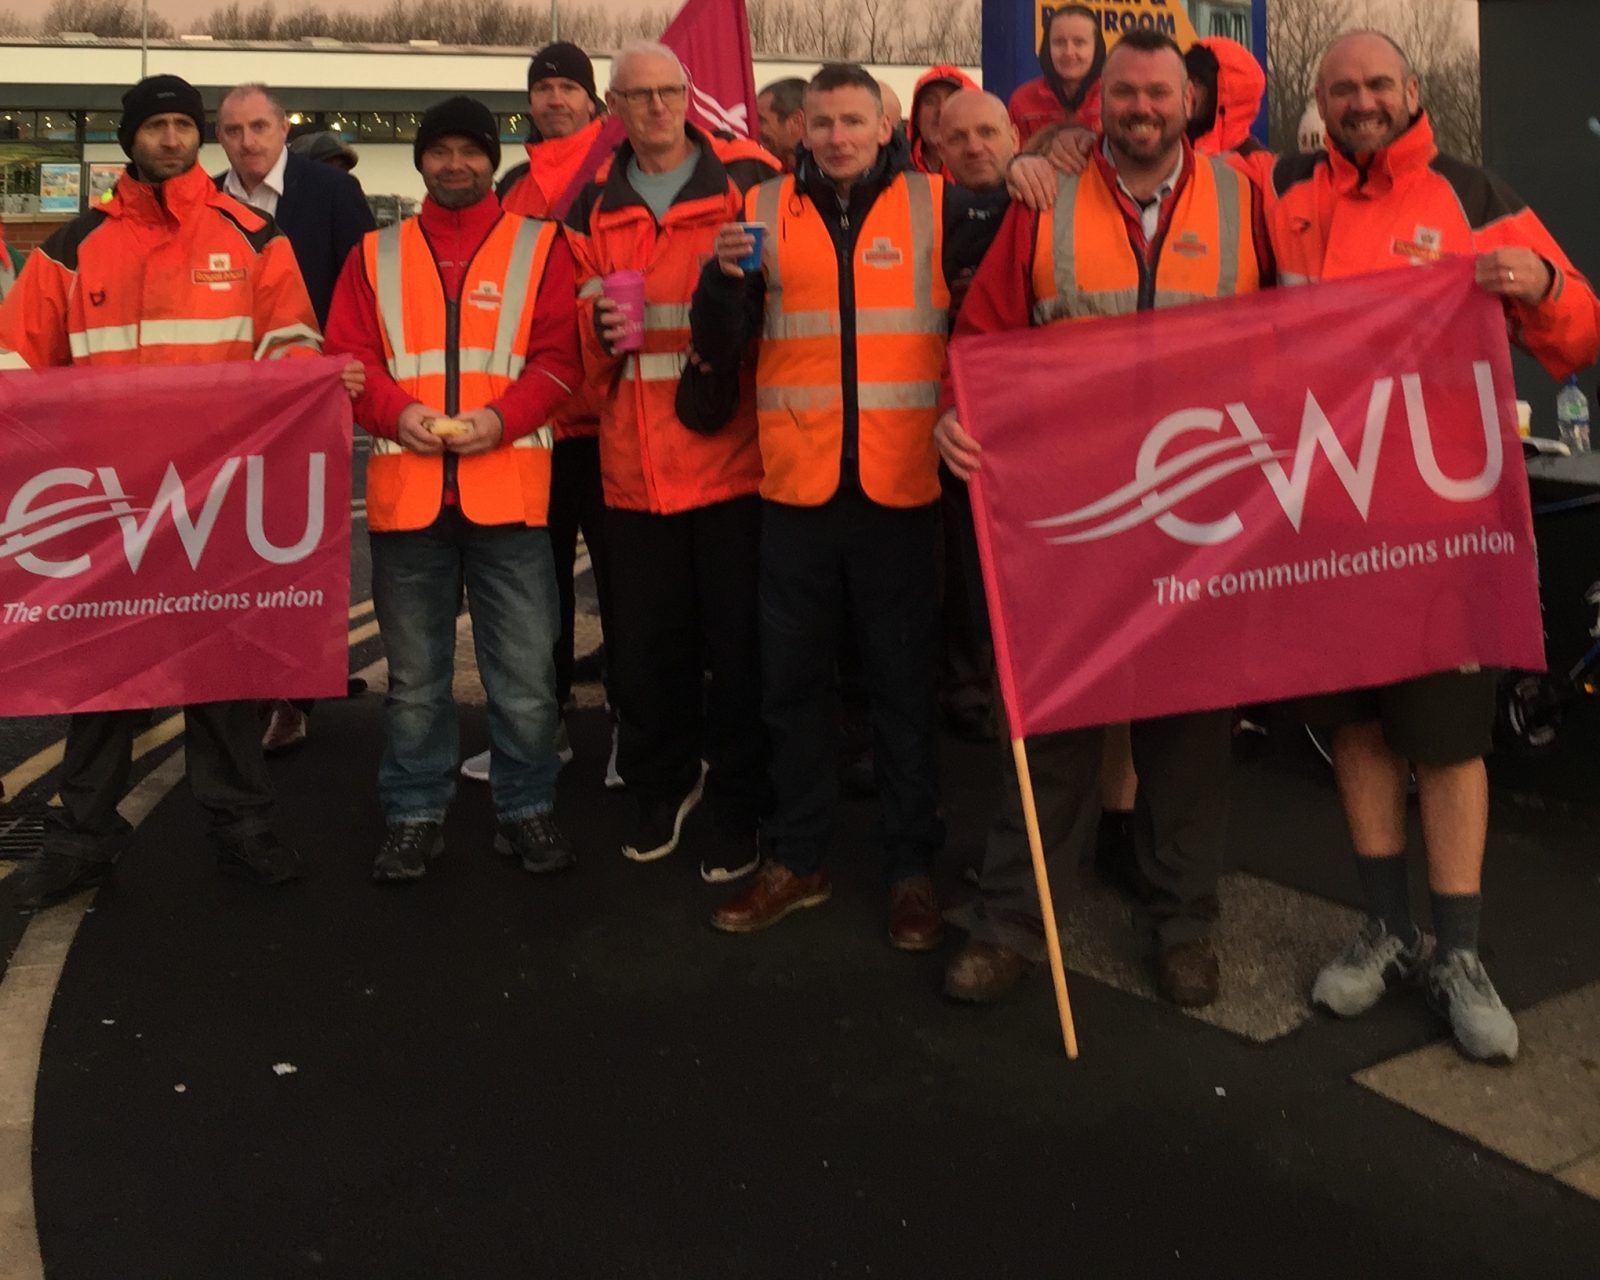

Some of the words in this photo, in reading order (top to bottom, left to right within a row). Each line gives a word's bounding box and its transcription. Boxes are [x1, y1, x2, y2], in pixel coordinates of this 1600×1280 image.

[1136, 360, 1504, 546] CWU
[2, 452, 326, 579] CWU
[1152, 576, 1201, 606] The
[1206, 538, 1438, 597] communications
[1445, 527, 1516, 560] union
[2, 602, 42, 623] The
[46, 590, 250, 620] communications
[255, 586, 324, 610] union
